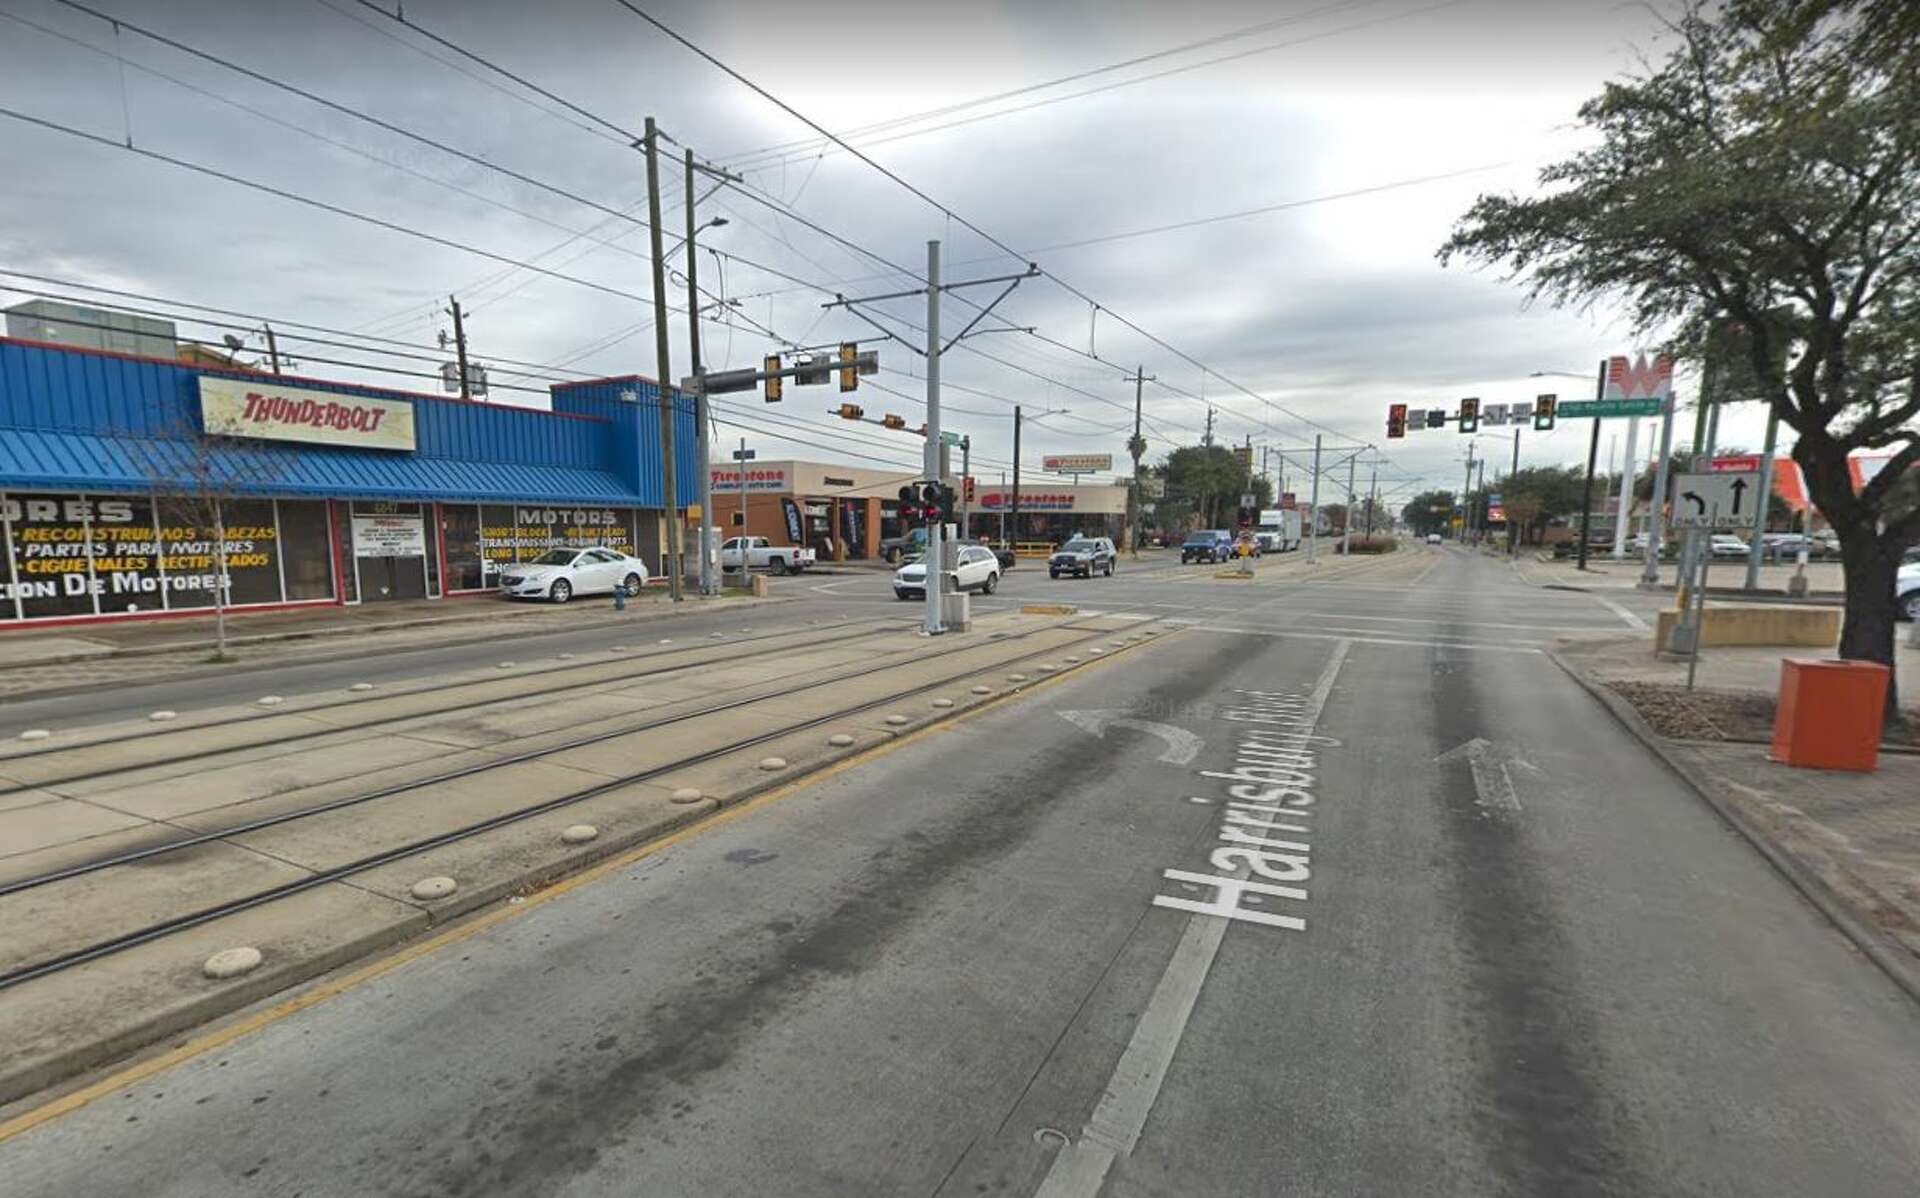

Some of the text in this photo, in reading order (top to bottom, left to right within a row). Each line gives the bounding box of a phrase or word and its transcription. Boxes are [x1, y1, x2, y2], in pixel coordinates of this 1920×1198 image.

[242, 392, 386, 432] THUNDERBOLT
[1004, 493, 1074, 503] Frestone
[519, 510, 617, 525] MOTORS
[1717, 516, 1754, 525] ONLY
[203, 527, 276, 539] BEZAS
[25, 543, 108, 557] PARTES
[115, 542, 162, 556] PARA
[157, 553, 270, 569] RECTIFADOS
